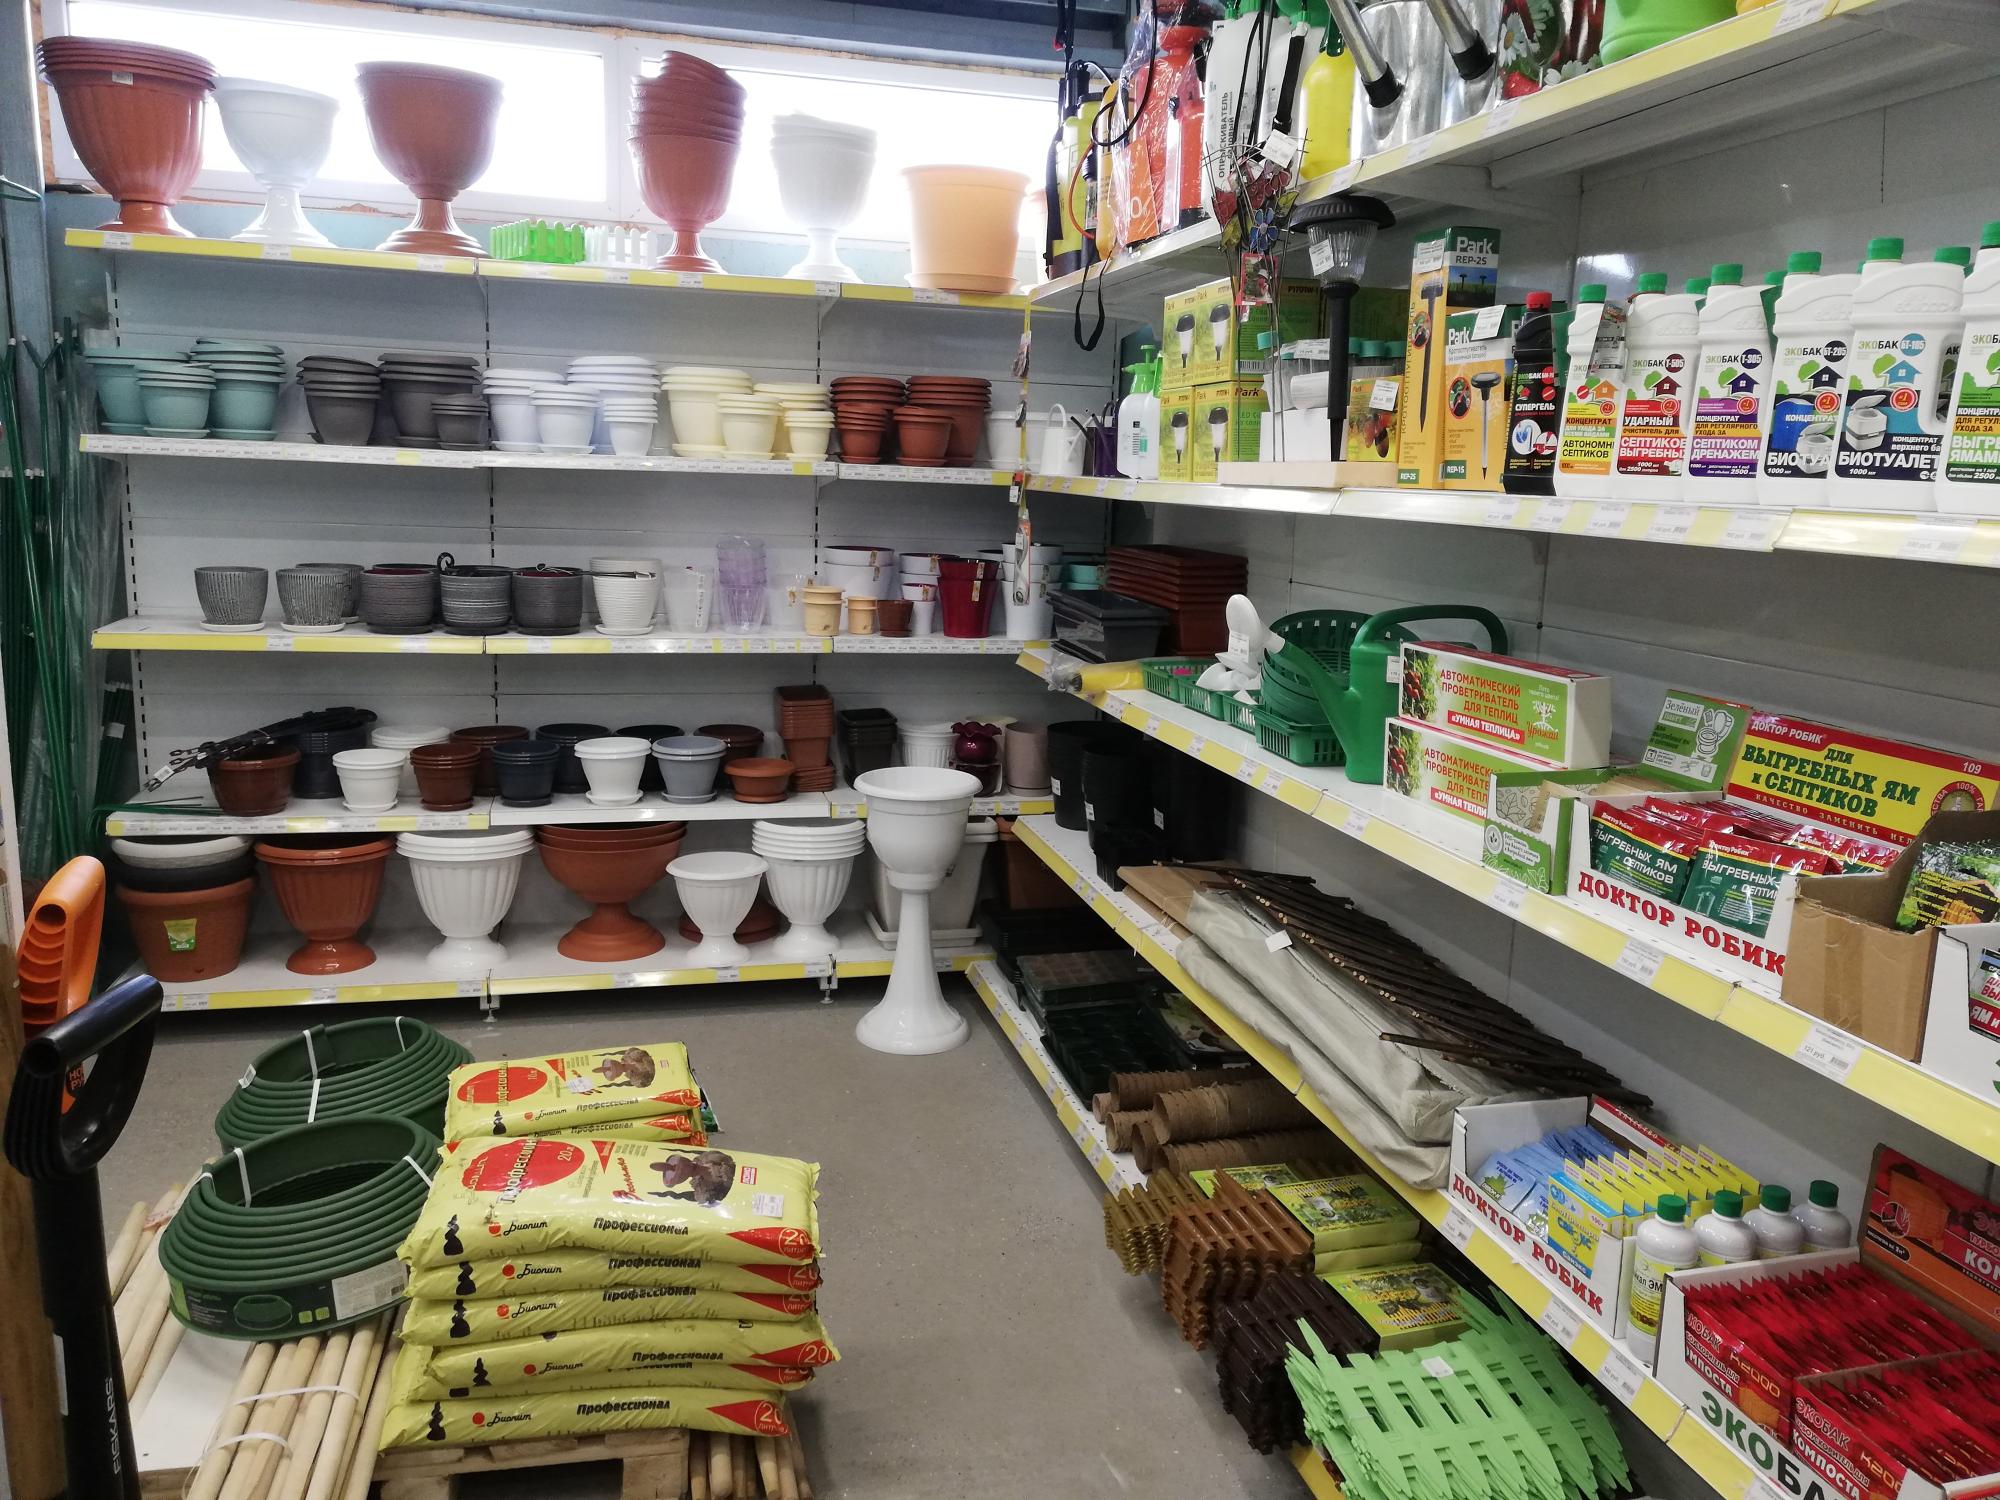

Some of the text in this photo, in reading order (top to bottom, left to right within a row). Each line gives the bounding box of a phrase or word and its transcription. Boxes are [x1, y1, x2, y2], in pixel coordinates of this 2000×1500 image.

[1456, 237, 1494, 255] Park
[1455, 256, 1487, 265] REP-2S
[1448, 328, 1470, 346] Park
[1858, 340, 1899, 350] ЭКОБАК
[1706, 355, 1740, 364] ЭКОБАК
[1784, 347, 1822, 357] ЭКОБАК
[1632, 359, 1664, 368] ЭКОБАК
[1235, 387, 1260, 397] Park
[1515, 403, 1555, 412] СУПЕРГЕЛЬ
[1565, 417, 1612, 425] КОНЦЕНТРАТ
[1624, 414, 1673, 426] УДАРНЫЙ
[1696, 415, 1739, 423] КОНЦЕНТРАТ
[1785, 413, 1838, 423] КОНЦЕНТРАТ
[1956, 417, 1973, 425] ДЛЯ
[1622, 427, 1663, 435] ОЧИСТИТЕЛЬ
[1693, 438, 1758, 449] СЕПТИКОМ
[1891, 444, 1929, 452] верхнего
[1892, 436, 1939, 445] КОНЦЕНТРАТ
[1562, 448, 1609, 459] СЕПТИКОВ
[1691, 449, 1759, 460] ДРЕНАЖЕМ
[1400, 472, 1417, 481] REP-2S
[1446, 465, 1465, 475] REP-1S
[1973, 472, 1995, 480] 2500
[1440, 669, 1521, 697] АВТОМАТИЧЕСКИЙ
[1442, 682, 1519, 711] ПРОВЕТРИВАТЕЛЬ
[1463, 700, 1518, 726] ДЛЯ ТЕПЛИЦ
[1665, 700, 1701, 717] Зелёный
[1451, 713, 1521, 741] «УМНАЯ ТЕПЛИЦА»
[1752, 720, 1823, 744] ДОКТОР РОБИК
[1742, 744, 1920, 806] ВЫГРЕБНЫХ ЯМ
[1446, 780, 1465, 794] ДЛЯ
[1765, 771, 1879, 817] СЕПТИКОВ
[1956, 781, 1977, 796] 100%
[1434, 791, 1462, 809] «УМНАЯ
[1755, 793, 1809, 815] КАЧЕСТВО
[1819, 812, 1878, 836] ЗАМЕНИТЬ
[1623, 856, 1674, 885] СЕПТИКОВ
[1656, 858, 1678, 874] ЯМ
[1579, 872, 1676, 928] ДОКТОР
[1684, 916, 1787, 977] РОБИК
[1971, 1005, 1993, 1025] ЯМ
[504, 1219, 549, 1237] Биопит
[593, 1217, 690, 1236] Профессионал
[1453, 1173, 1526, 1246] ДОКТОР
[1531, 1240, 1604, 1317] РОБИК
[517, 1263, 563, 1280] Биопит
[608, 1257, 702, 1271] Профессионал
[602, 1286, 698, 1302] Профессионал
[511, 1301, 558, 1319] Биопит
[631, 1351, 724, 1362] Профессионал
[803, 1345, 830, 1364] 20
[538, 1361, 585, 1375] Биопит
[576, 1400, 671, 1416] Профессионал
[106, 1377, 121, 1475] FISKARS
[487, 1411, 533, 1427] Биопит
[1796, 1397, 1851, 1452] ЭКОБАК
[1793, 1428, 1861, 1500] КОМПОСТА
[1854, 1467, 1870, 1488] ДЛЯ
